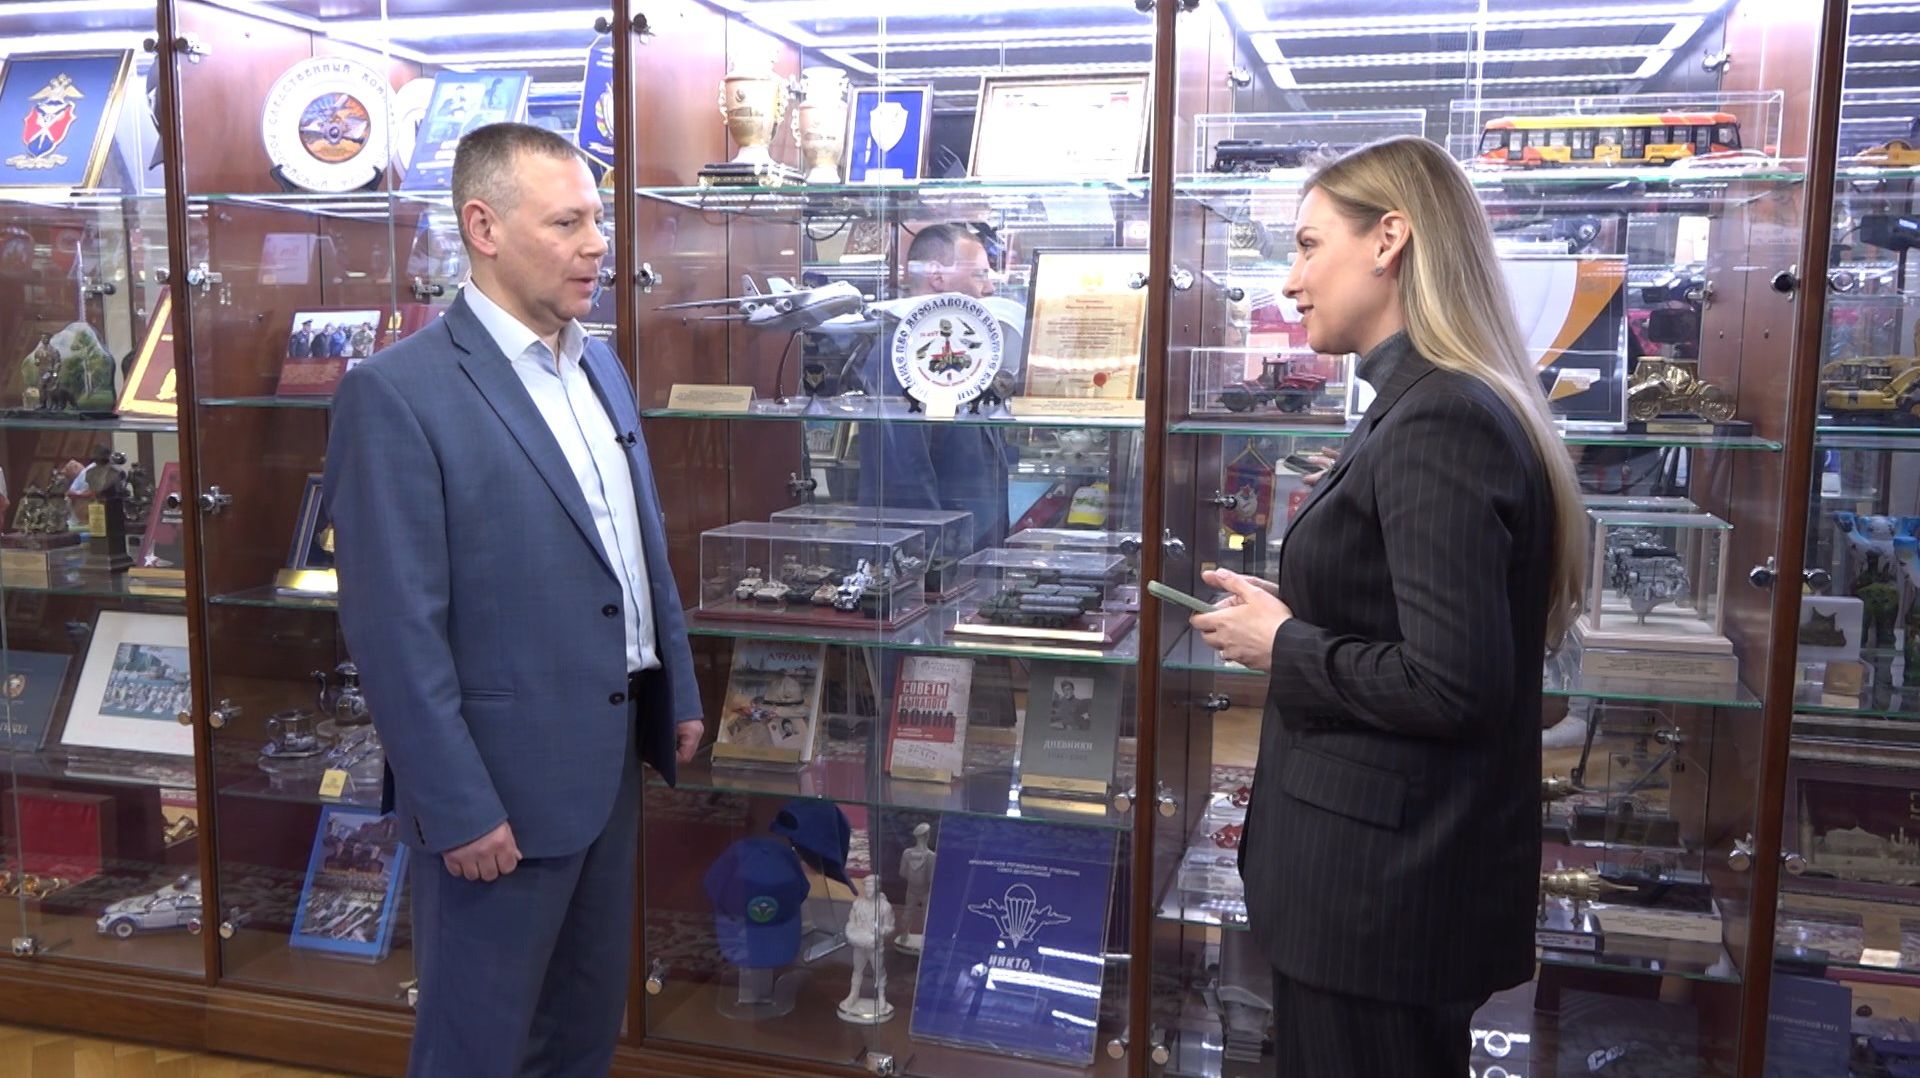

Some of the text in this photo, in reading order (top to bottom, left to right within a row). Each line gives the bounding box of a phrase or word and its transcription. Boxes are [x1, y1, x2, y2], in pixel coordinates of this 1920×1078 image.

[902, 681, 948, 696] СОВЕТЫ
[899, 708, 956, 728] ВОИНА
[1042, 739, 1094, 751] ДНЕВНИКИ
